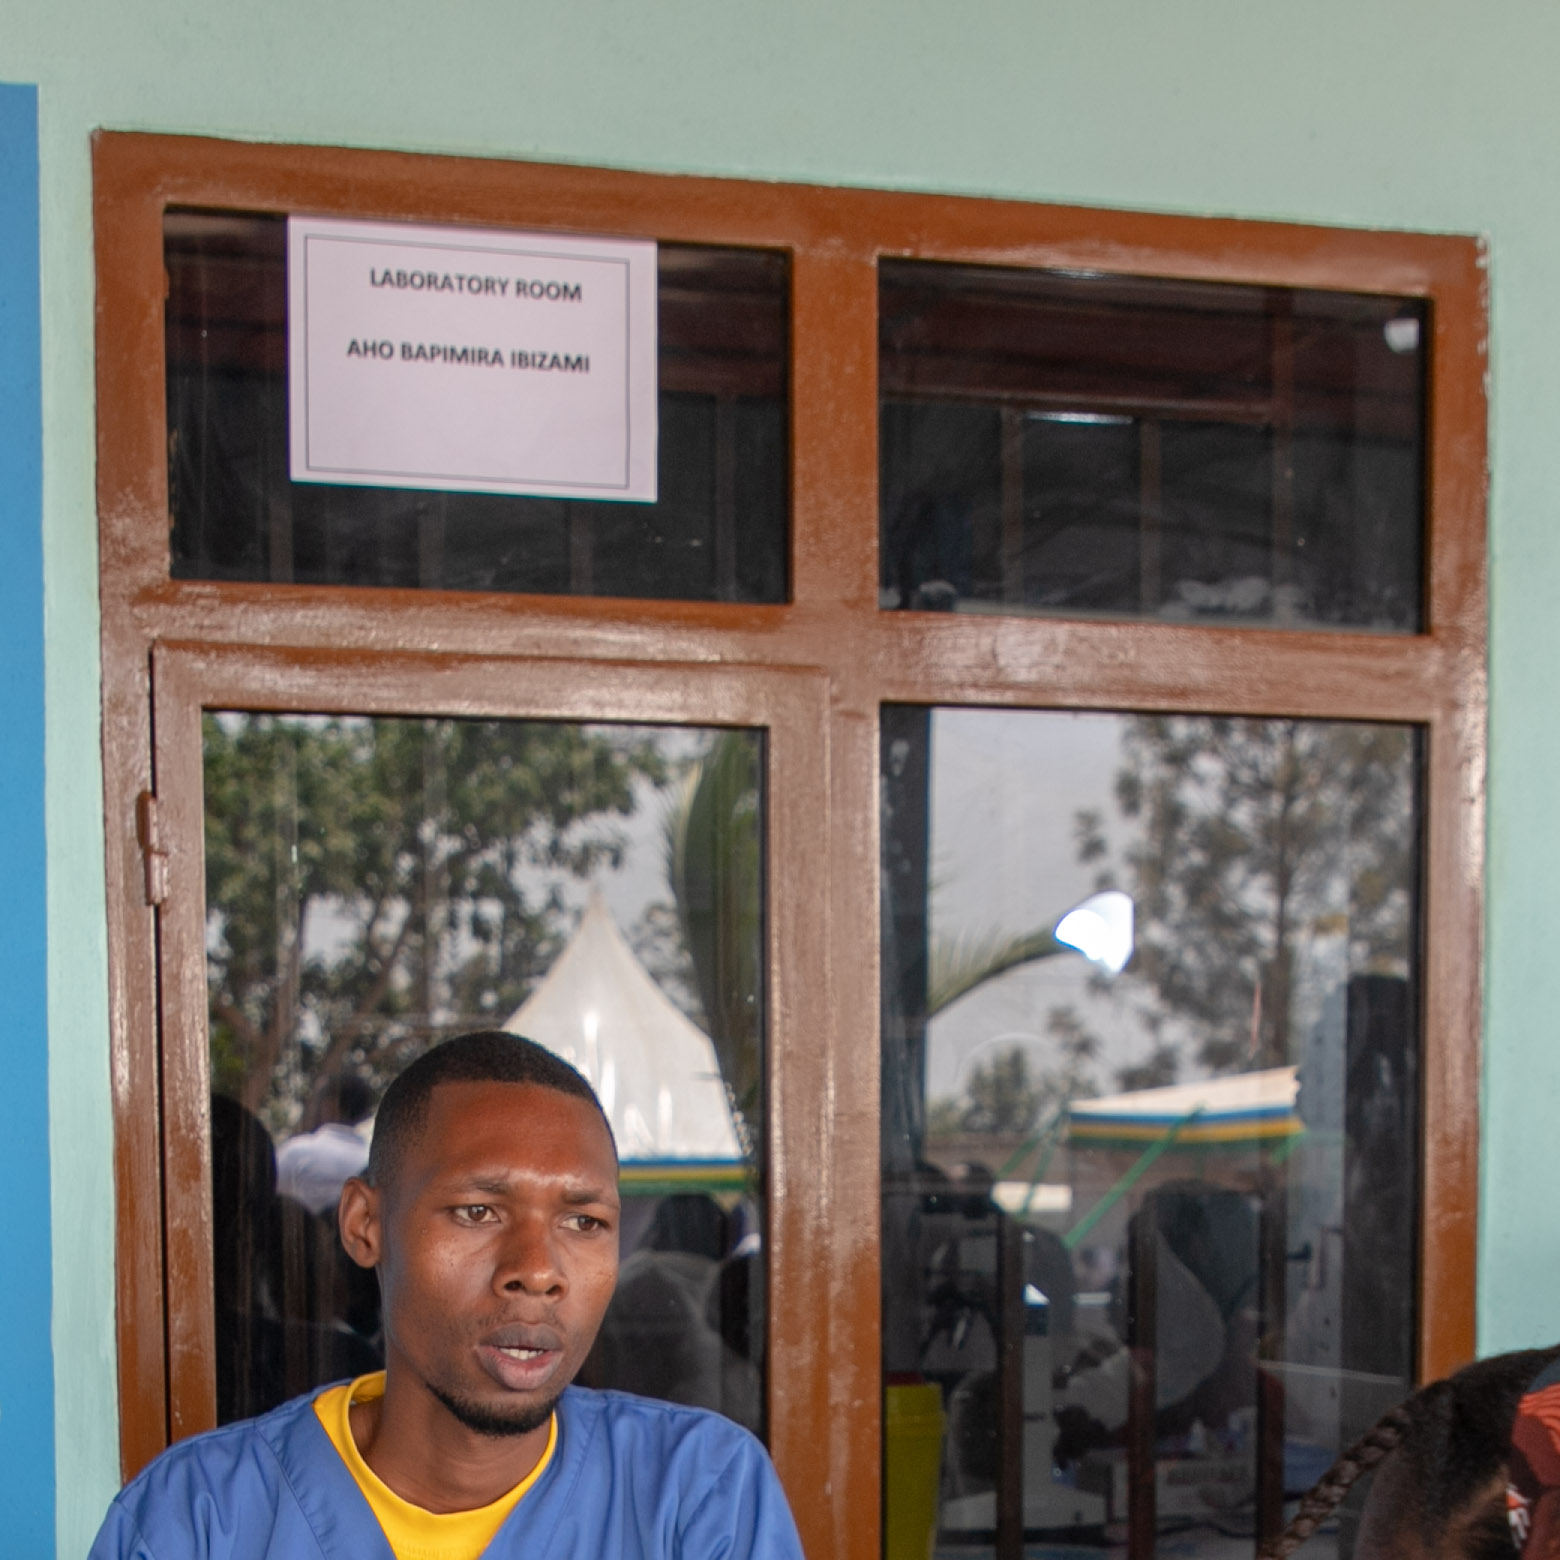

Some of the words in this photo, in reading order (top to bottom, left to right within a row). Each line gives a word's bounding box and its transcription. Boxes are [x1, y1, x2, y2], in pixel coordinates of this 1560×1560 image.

[369, 267, 509, 296] LABORATORY
[515, 278, 583, 301] ROOM
[346, 338, 395, 360] AHO
[400, 341, 505, 366] BAPIMIRA
[510, 350, 590, 372] IBIZAMI
